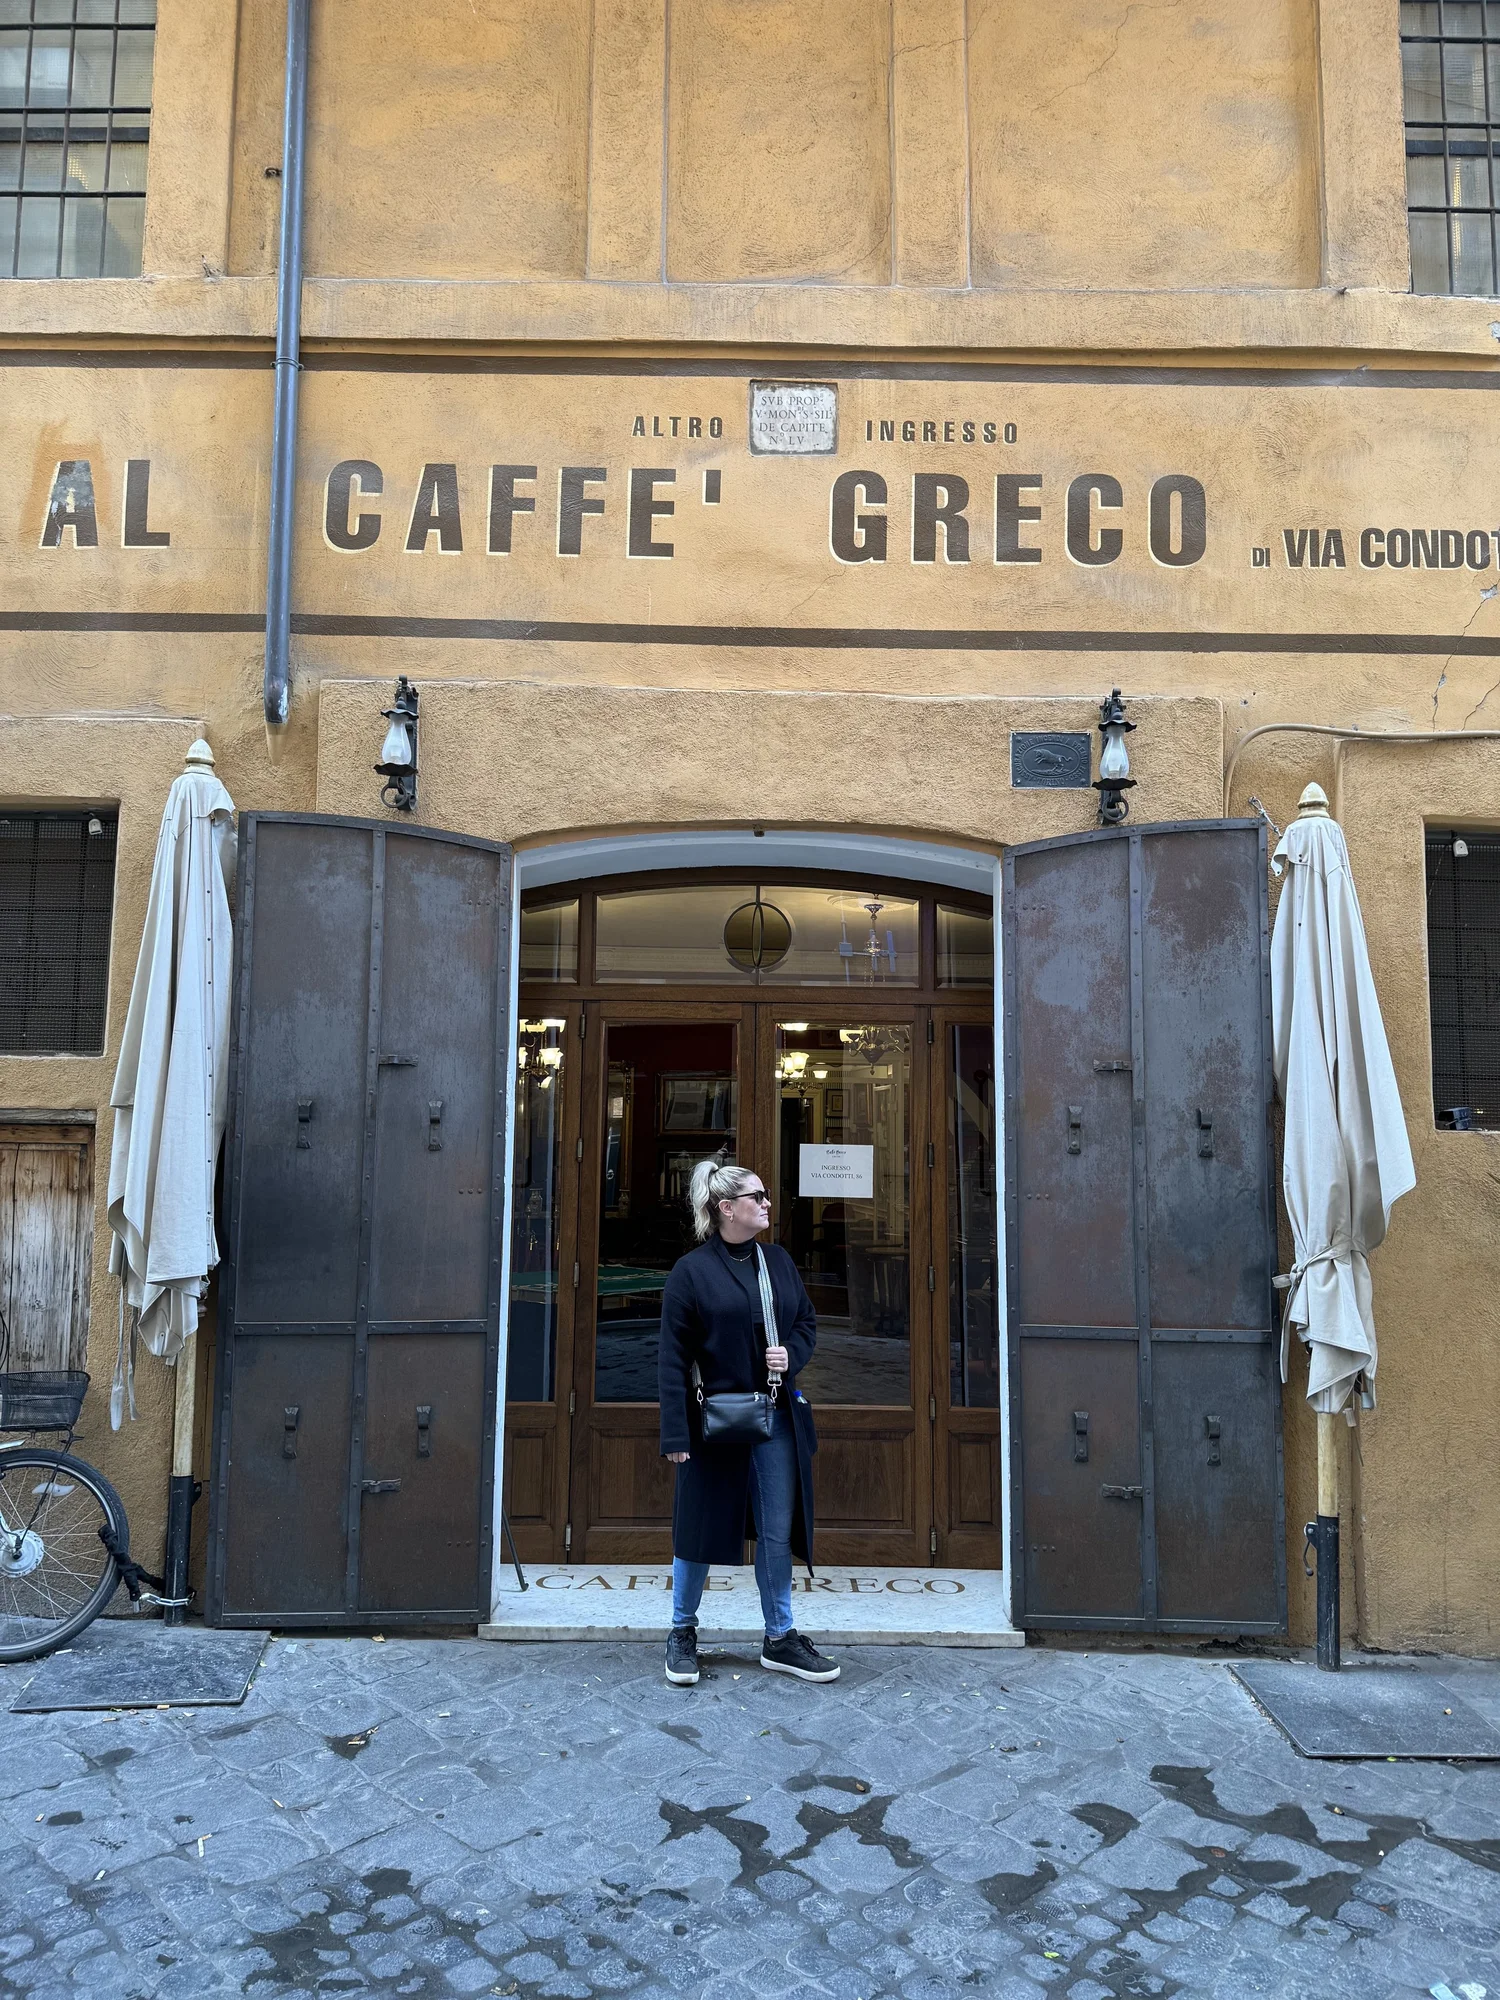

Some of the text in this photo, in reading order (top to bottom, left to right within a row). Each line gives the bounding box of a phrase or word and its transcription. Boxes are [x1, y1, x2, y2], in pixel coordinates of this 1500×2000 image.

[631, 415, 1018, 445] ALTRO INGRESSO
[759, 422, 826, 433] DE CAPITE
[38, 458, 170, 550] AL
[828, 469, 1207, 569] GRECO
[1250, 547, 1270, 569] DI
[1282, 528, 1346, 570] VIA
[1071, 740, 1088, 764] PREMIO
[791, 1577, 966, 1595] RECO
